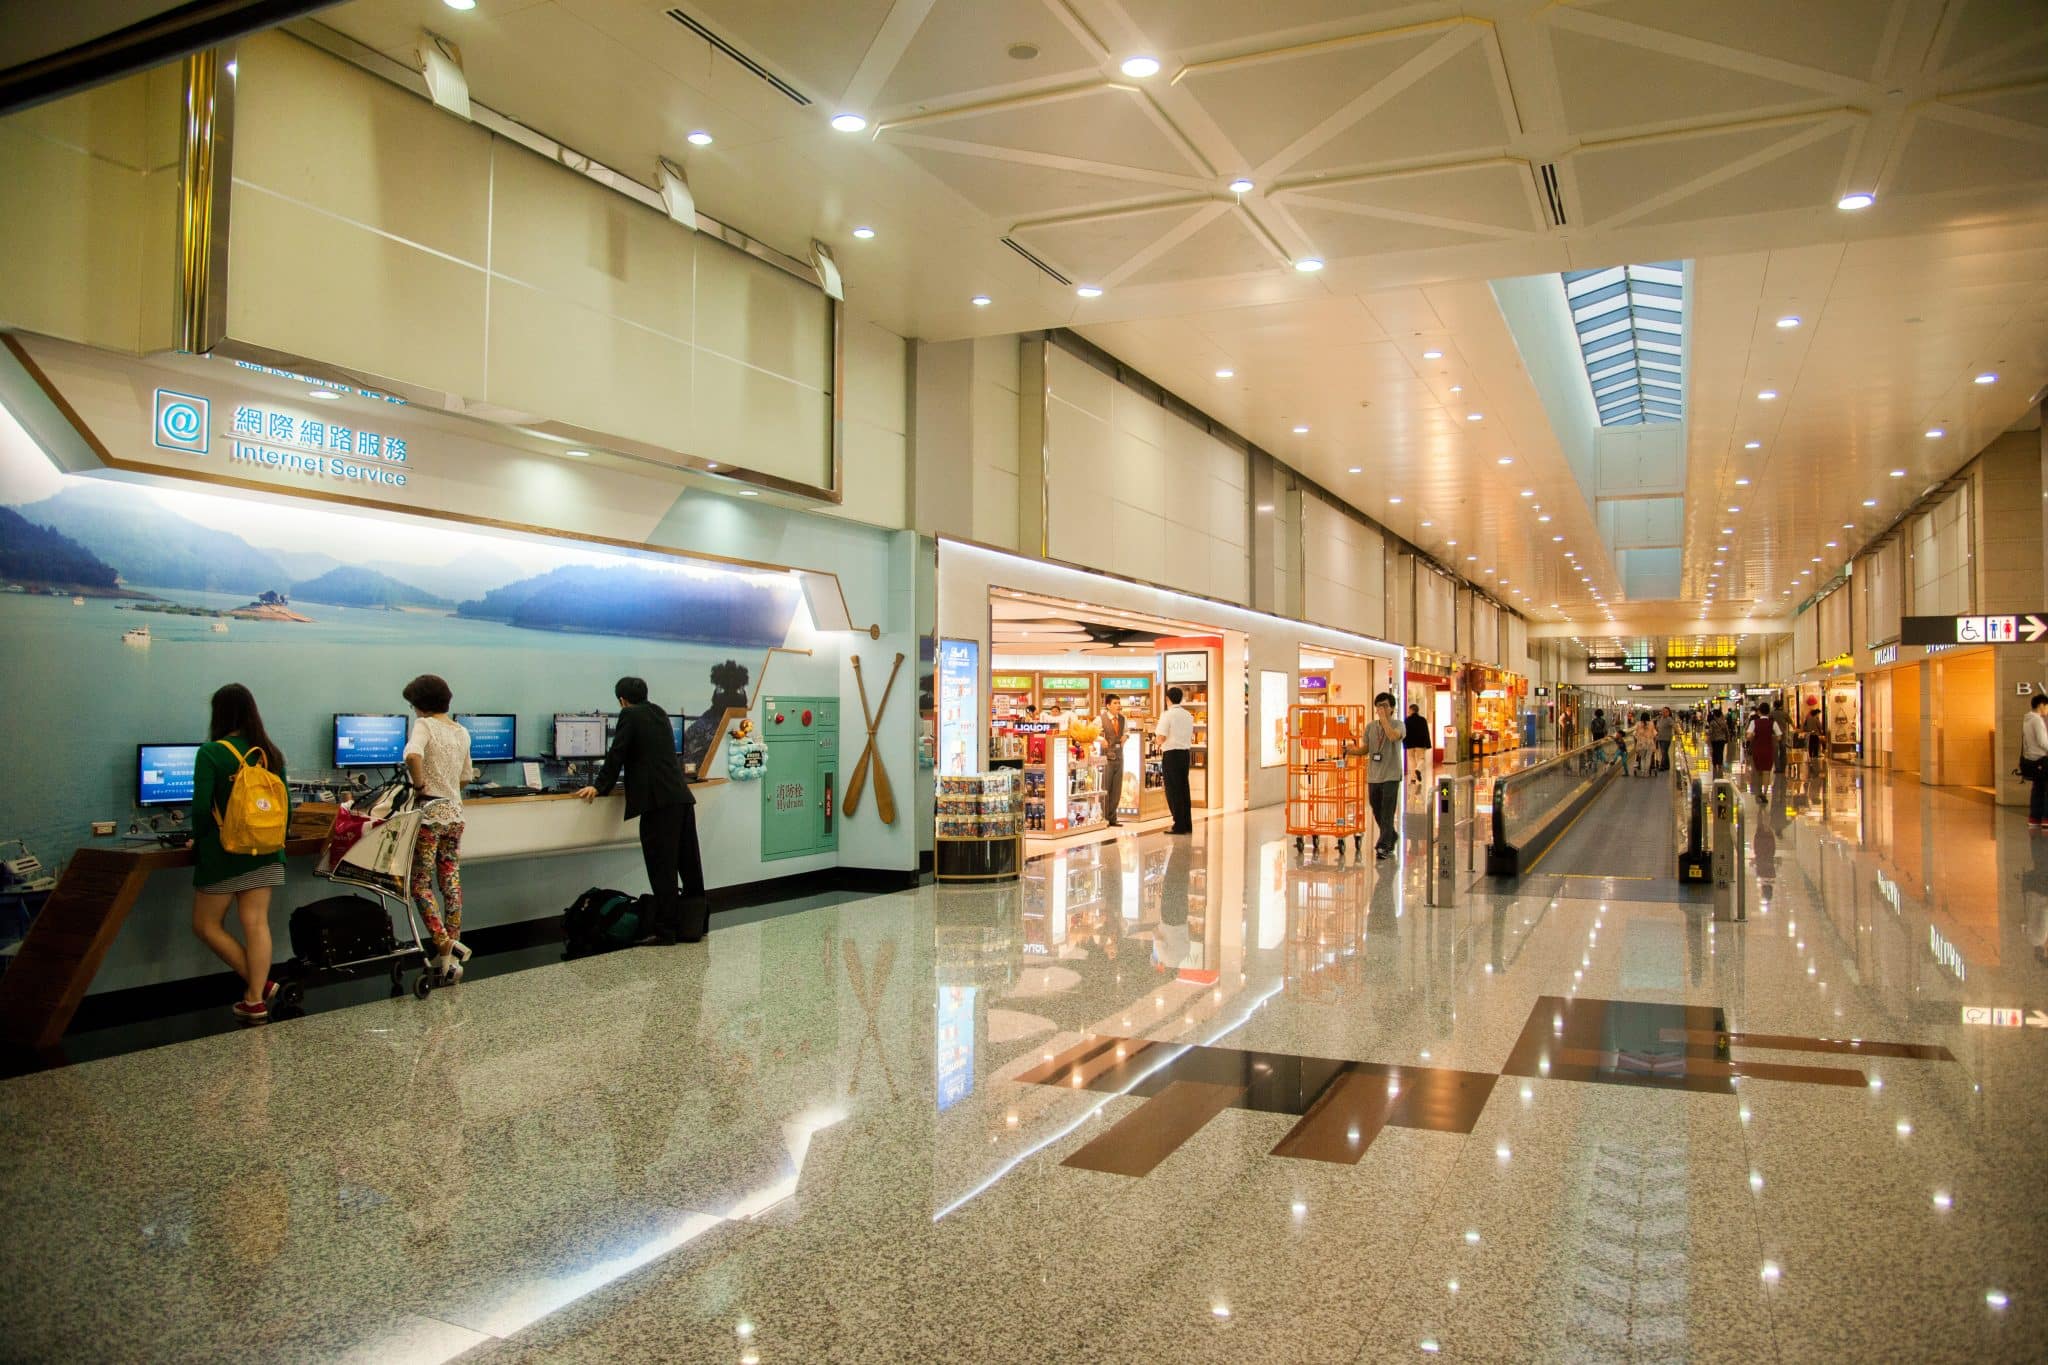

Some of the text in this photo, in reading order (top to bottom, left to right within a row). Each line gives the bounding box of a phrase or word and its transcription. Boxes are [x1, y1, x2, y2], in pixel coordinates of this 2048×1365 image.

[235, 405, 407, 462] 網際網路服務
[234, 440, 407, 487] Internet Service
[1015, 723, 1050, 732] LIQUOR
[777, 798, 804, 811] Hydrant
